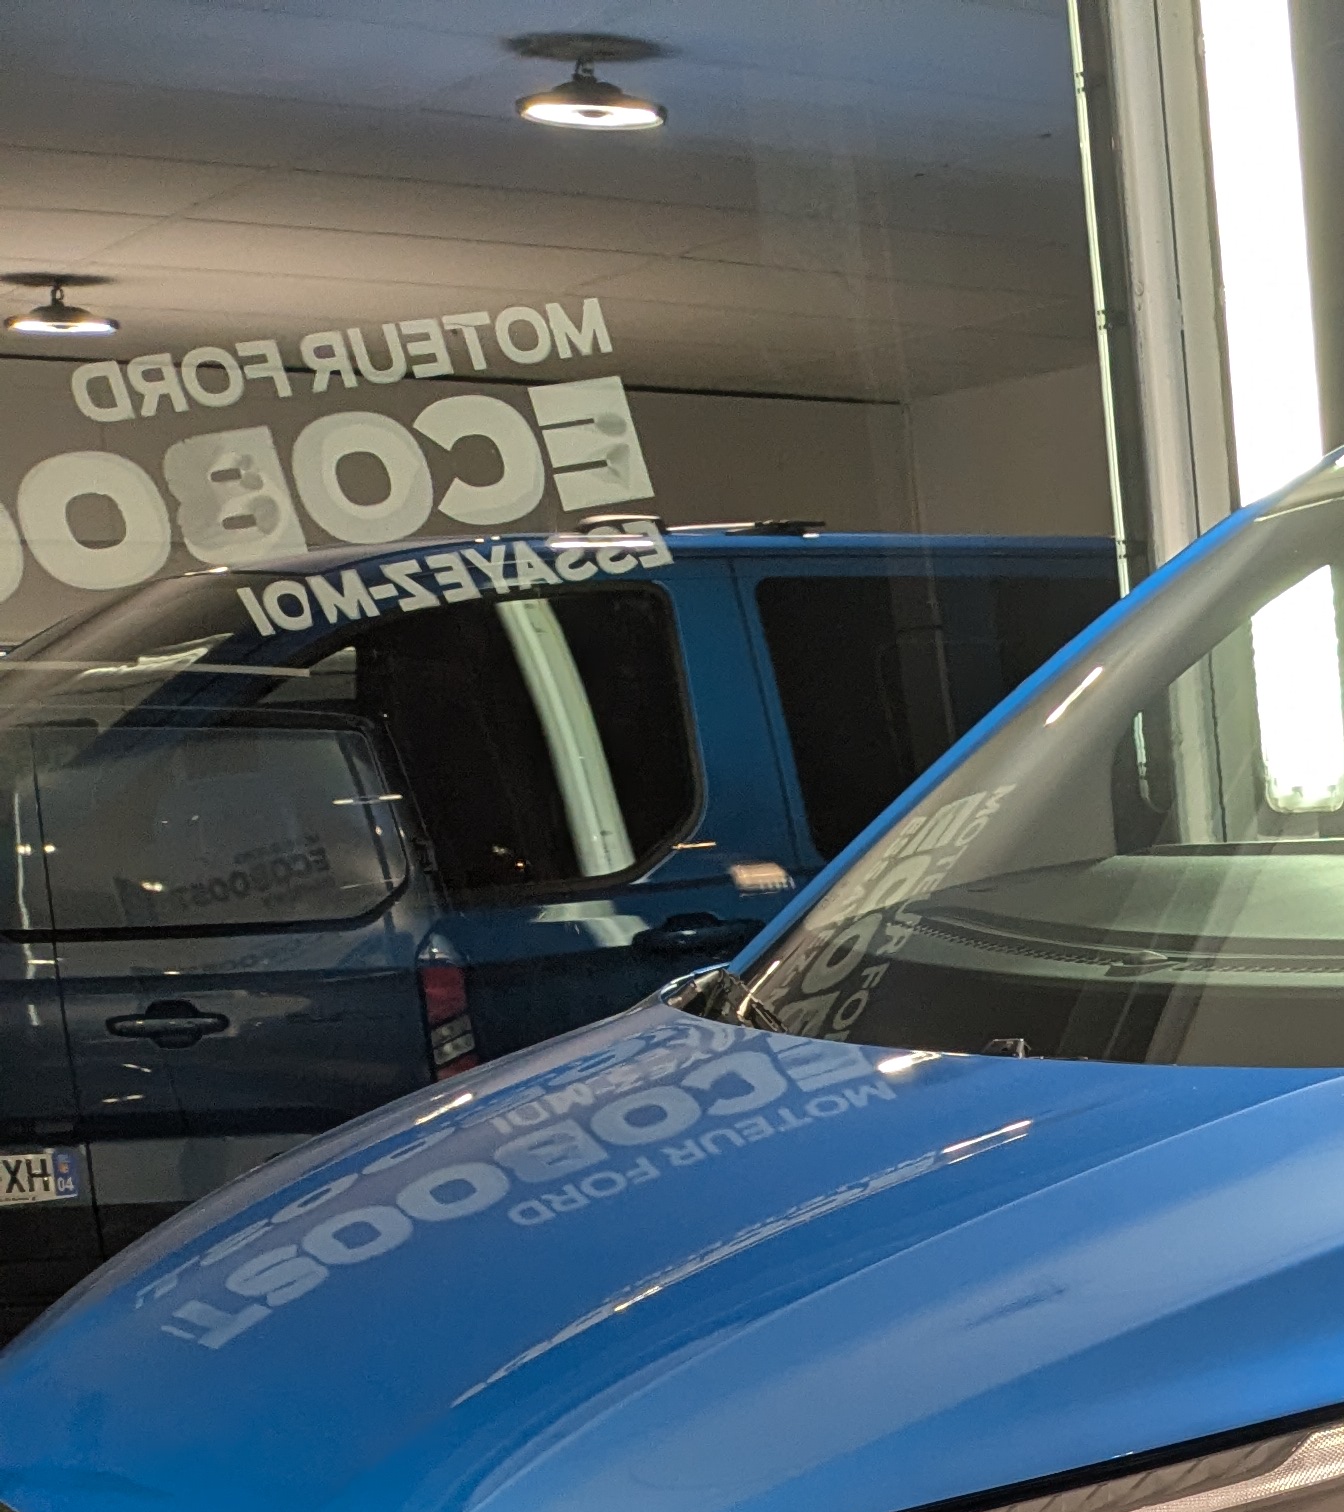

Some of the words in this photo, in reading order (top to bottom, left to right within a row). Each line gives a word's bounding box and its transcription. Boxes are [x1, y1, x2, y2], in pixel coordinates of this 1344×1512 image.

[662, 1079, 898, 1168] MOTEUR
[57, 1176, 75, 1193] 04
[172, 1033, 874, 1350] ECOBOOST
[506, 1155, 662, 1227] FORD
